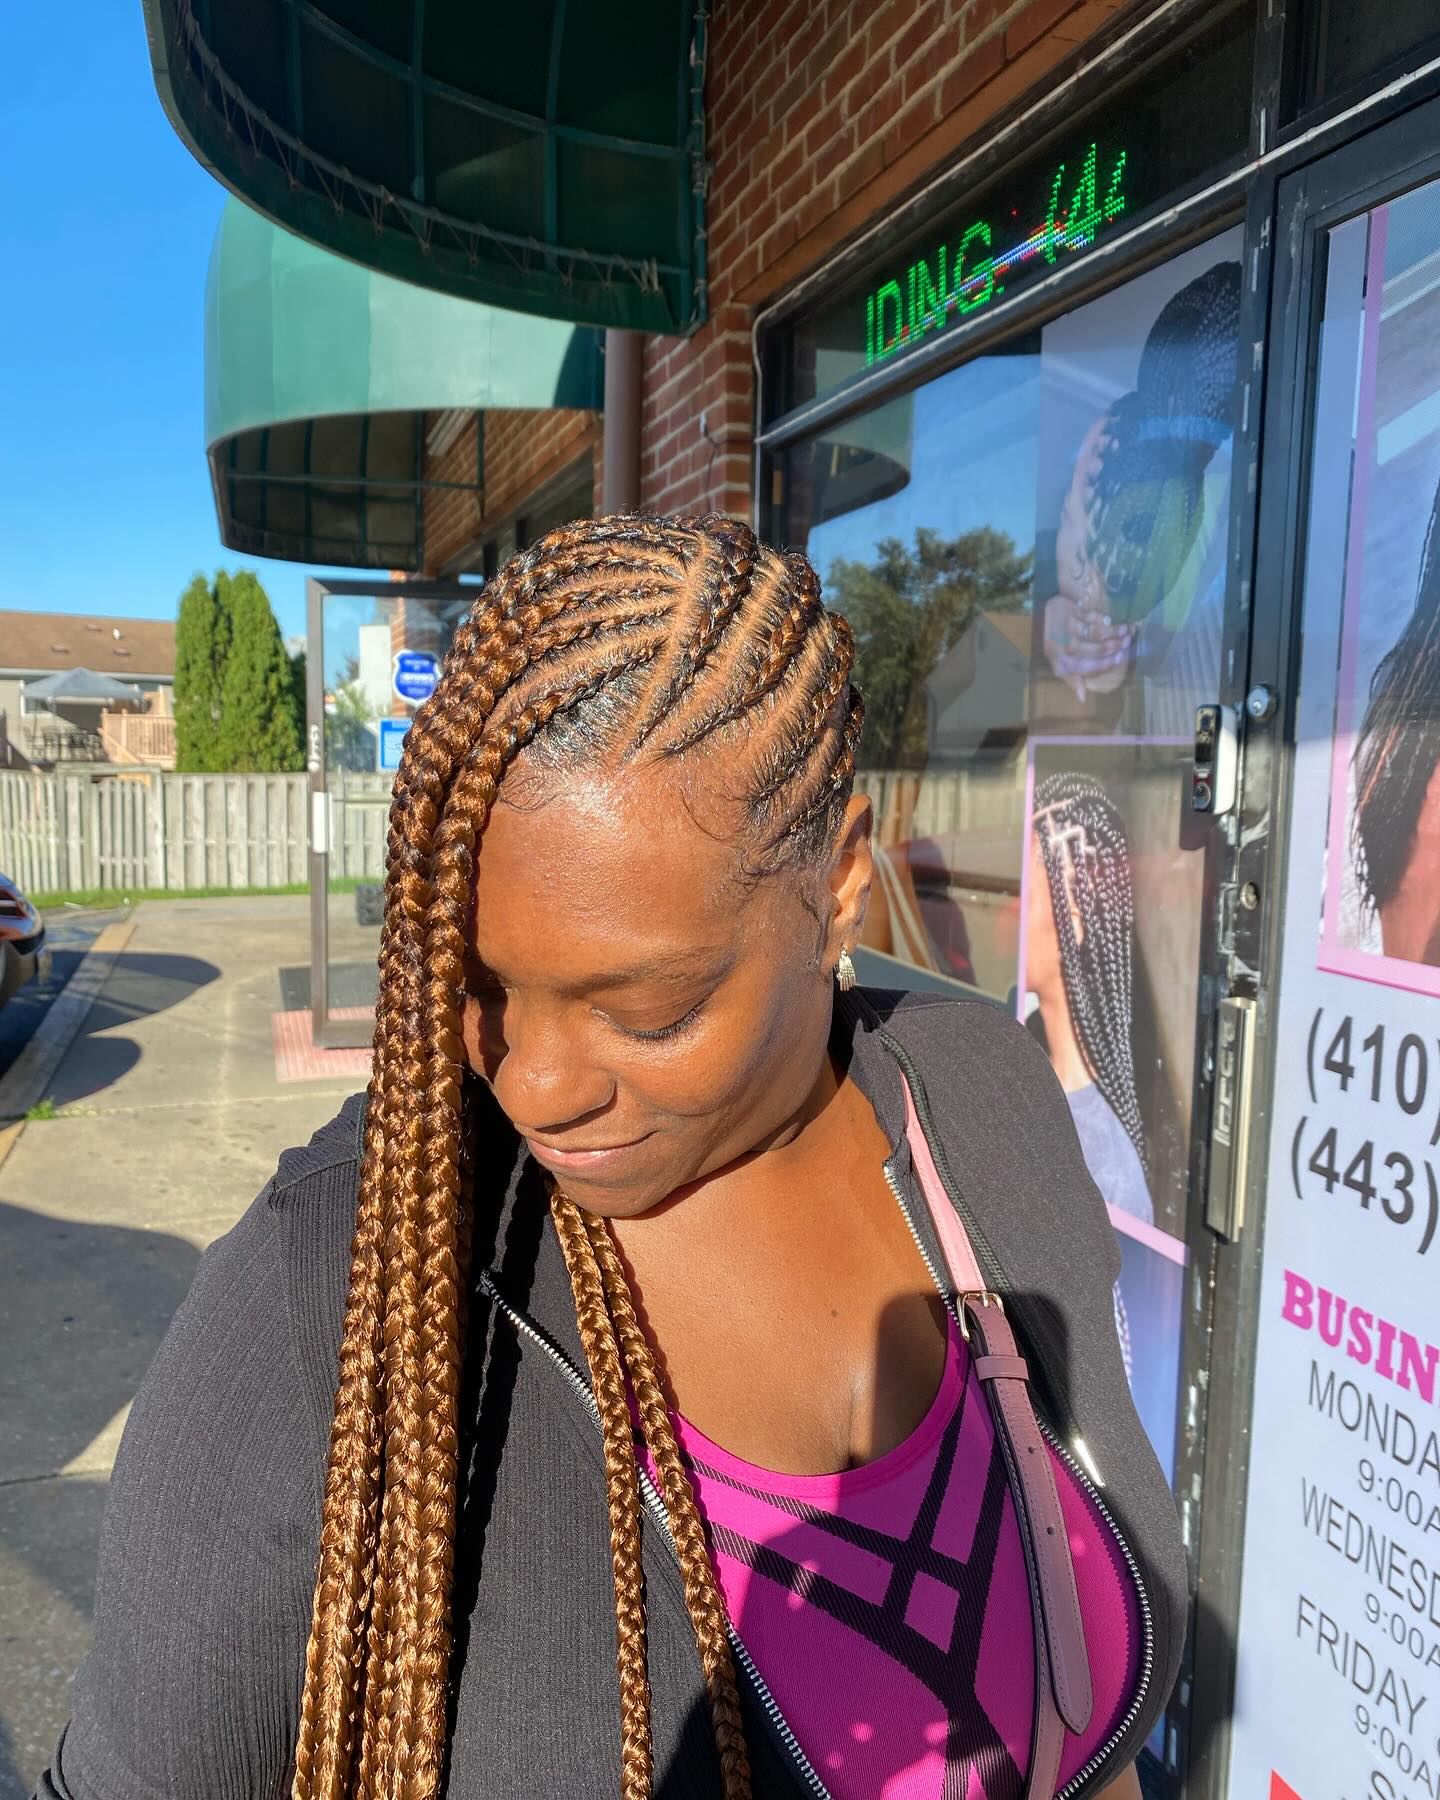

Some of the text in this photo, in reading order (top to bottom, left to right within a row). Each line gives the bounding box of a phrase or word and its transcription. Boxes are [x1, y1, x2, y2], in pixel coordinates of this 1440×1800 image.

[1291, 1115, 1439, 1255] (443)
[1297, 1593, 1428, 1736] FRIDAY
[1355, 1704, 1440, 1800] 9:00A
